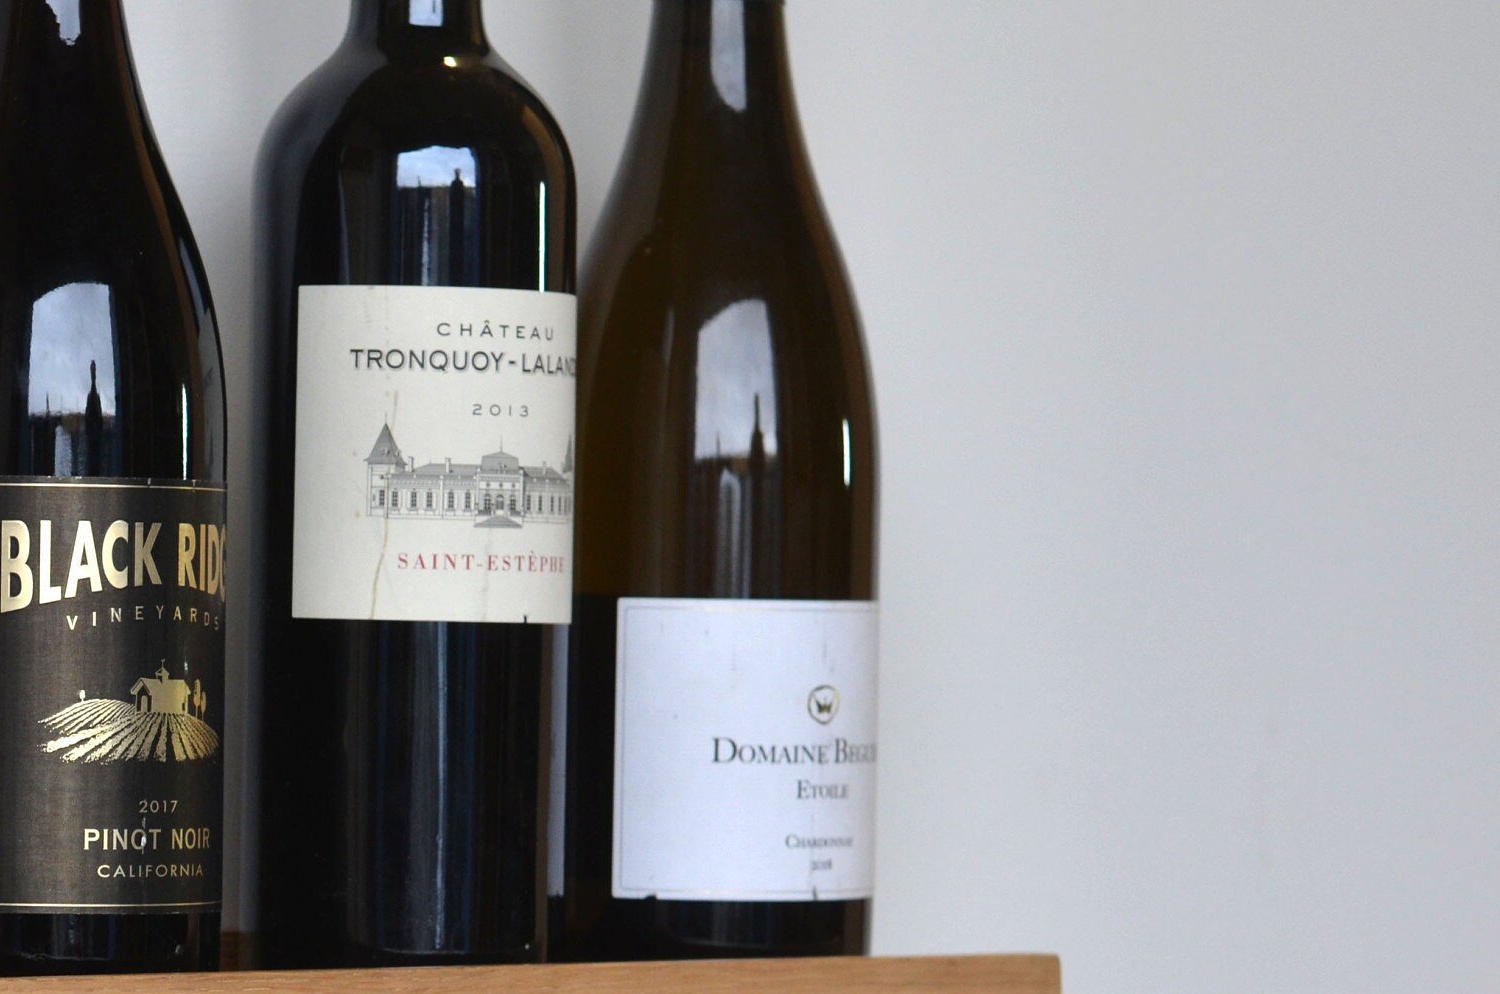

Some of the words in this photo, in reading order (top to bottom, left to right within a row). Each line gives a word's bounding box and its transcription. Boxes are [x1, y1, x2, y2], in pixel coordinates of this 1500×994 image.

[437, 320, 554, 341] CHÂTEAU
[472, 404, 529, 418] 2013
[0, 519, 162, 614] BLACK
[397, 551, 565, 573] SAINT-ESTÈPHE
[66, 605, 219, 631] VINEYARDS
[139, 800, 178, 814] 2017
[83, 828, 161, 850] PINOT
[171, 827, 211, 850] NOIR
[97, 864, 203, 878] CALIFORNIA
